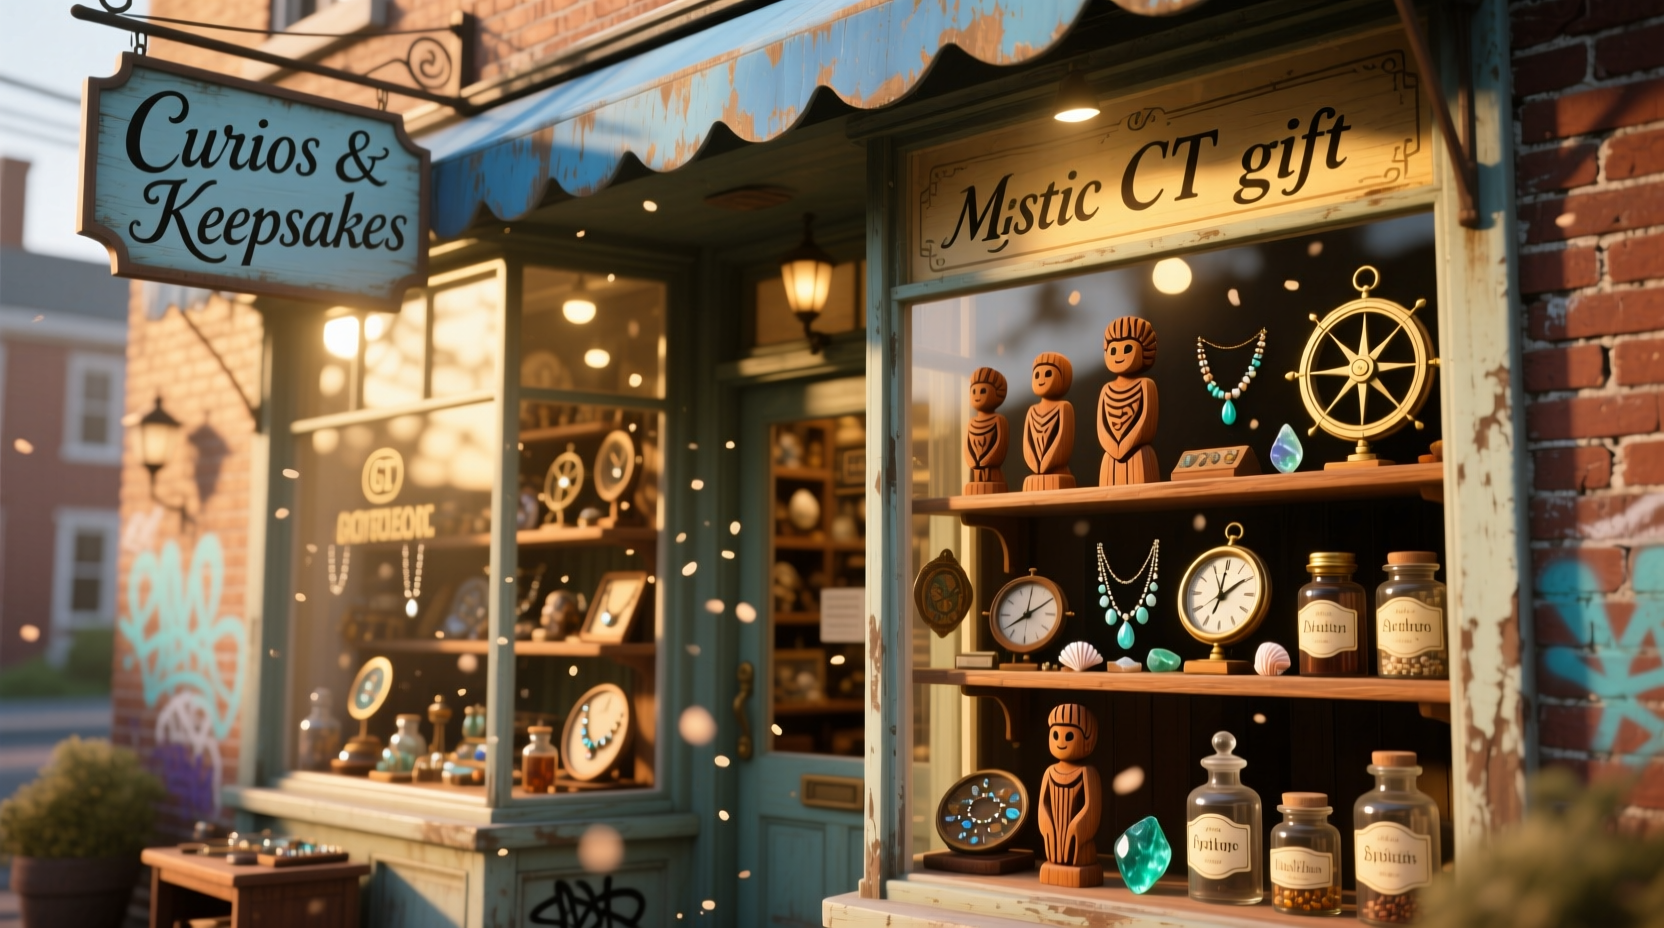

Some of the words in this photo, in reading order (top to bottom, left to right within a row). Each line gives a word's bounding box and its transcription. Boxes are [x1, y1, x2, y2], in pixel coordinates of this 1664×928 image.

[125, 90, 320, 177] Curios
[335, 130, 390, 187] &
[1121, 129, 1219, 211] CT
[1233, 106, 1352, 205] gift
[128, 178, 408, 266] Keepsakes
